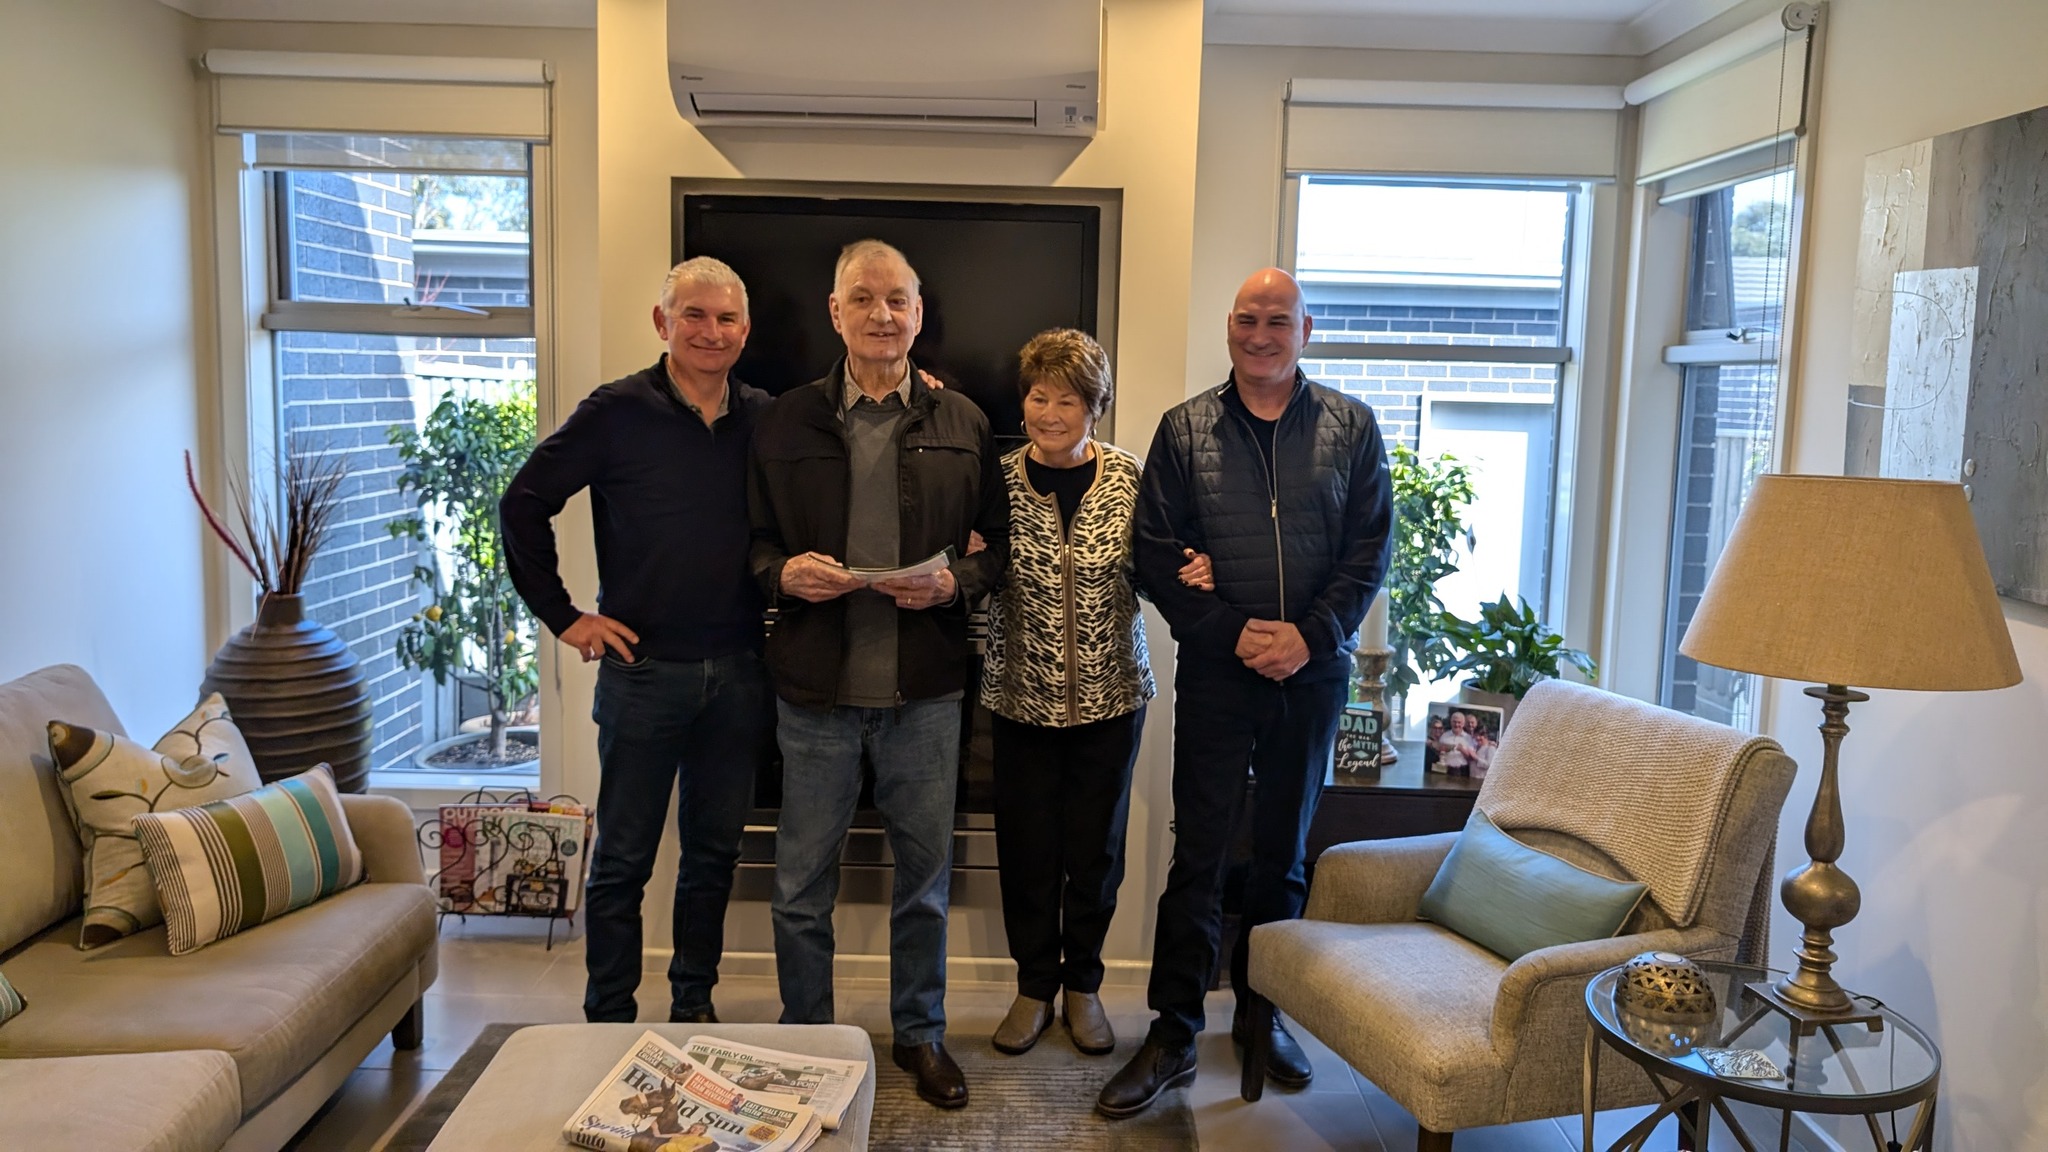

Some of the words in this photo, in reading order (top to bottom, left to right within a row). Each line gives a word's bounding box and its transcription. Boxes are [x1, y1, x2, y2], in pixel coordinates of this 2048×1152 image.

[1340, 714, 1377, 734] DAD
[1338, 737, 1352, 752] the
[1353, 740, 1378, 751] MYTH
[1335, 752, 1380, 773] Legend
[692, 1044, 710, 1052] THE
[710, 1048, 740, 1059] EARLY
[740, 1106, 762, 1117] POSTER
[581, 1114, 637, 1139] Spring
[699, 1111, 744, 1135] Sun
[577, 1127, 606, 1149] into
